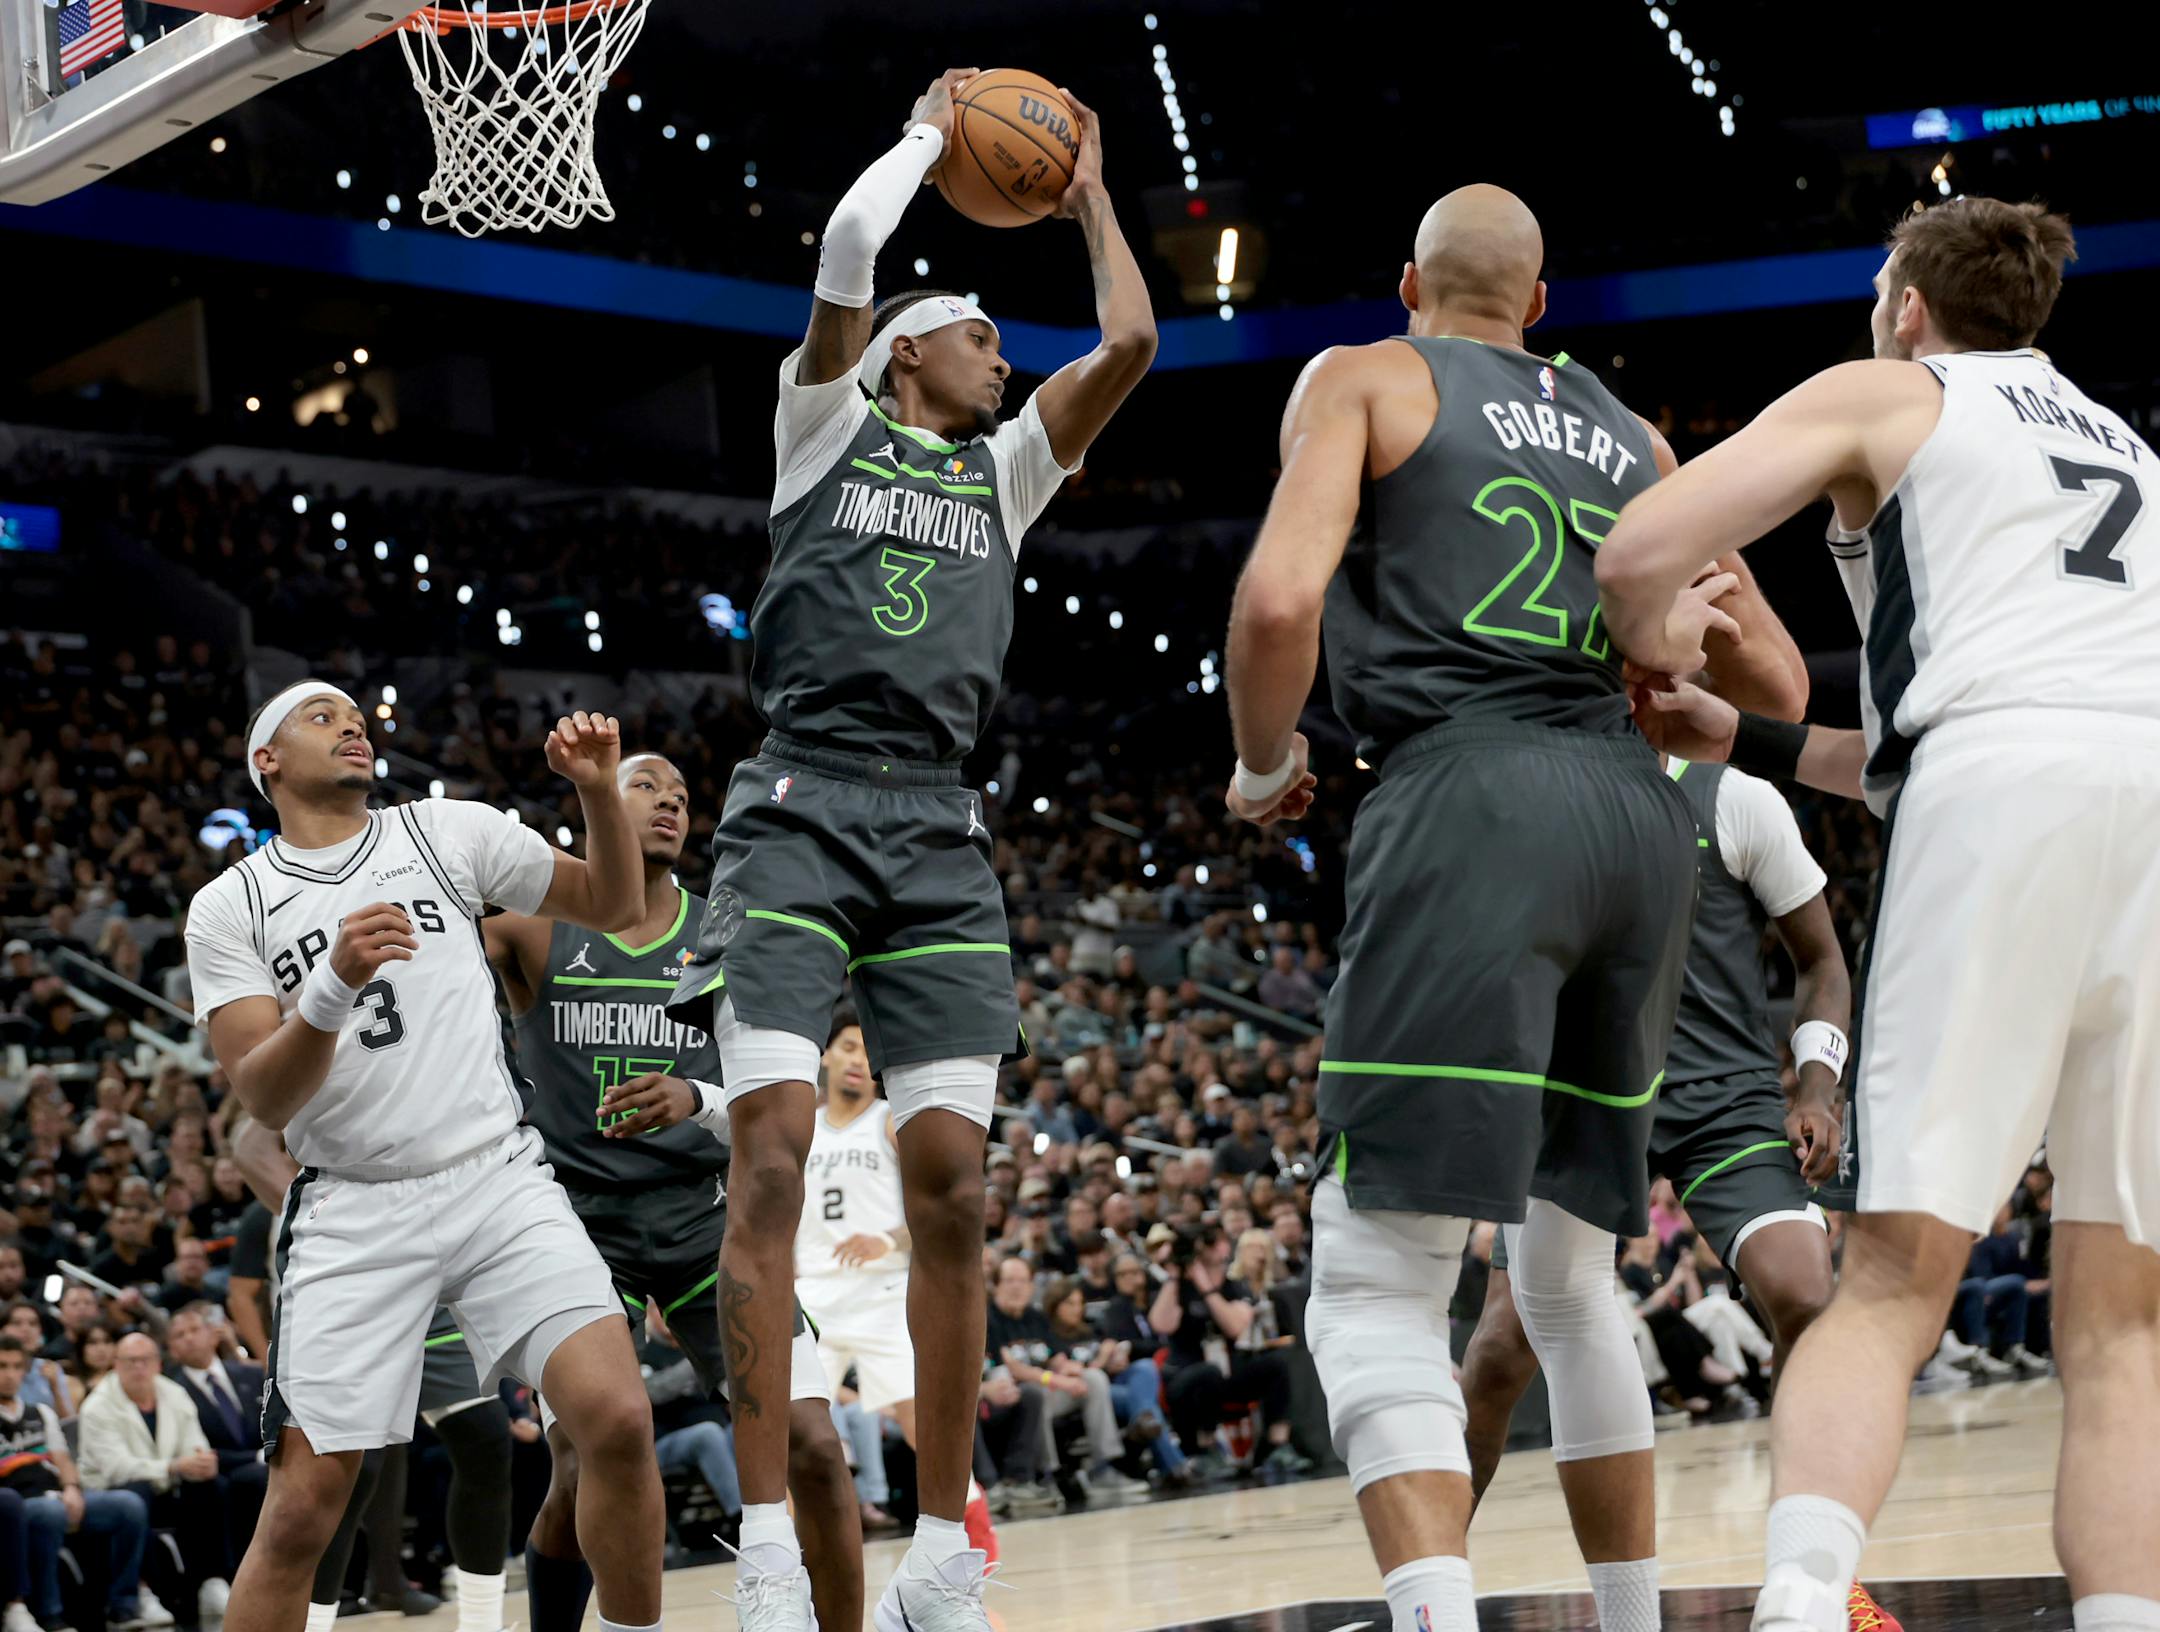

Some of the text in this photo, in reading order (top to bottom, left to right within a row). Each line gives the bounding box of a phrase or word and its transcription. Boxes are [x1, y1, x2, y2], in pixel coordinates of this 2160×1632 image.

[1018, 94, 1080, 160] Wilso
[2037, 100, 2102, 125] YEARS
[1482, 401, 1638, 486] GOBERT
[1994, 384, 2142, 464] KORNET
[831, 482, 991, 560] TIMBERWOLVES
[2038, 446, 2149, 590] 7
[871, 547, 937, 637] 3
[379, 864, 415, 881] LEDGER
[271, 900, 446, 994] SPS
[351, 976, 408, 1053] 3
[808, 1148, 880, 1179] PURS
[823, 1186, 844, 1220] 2
